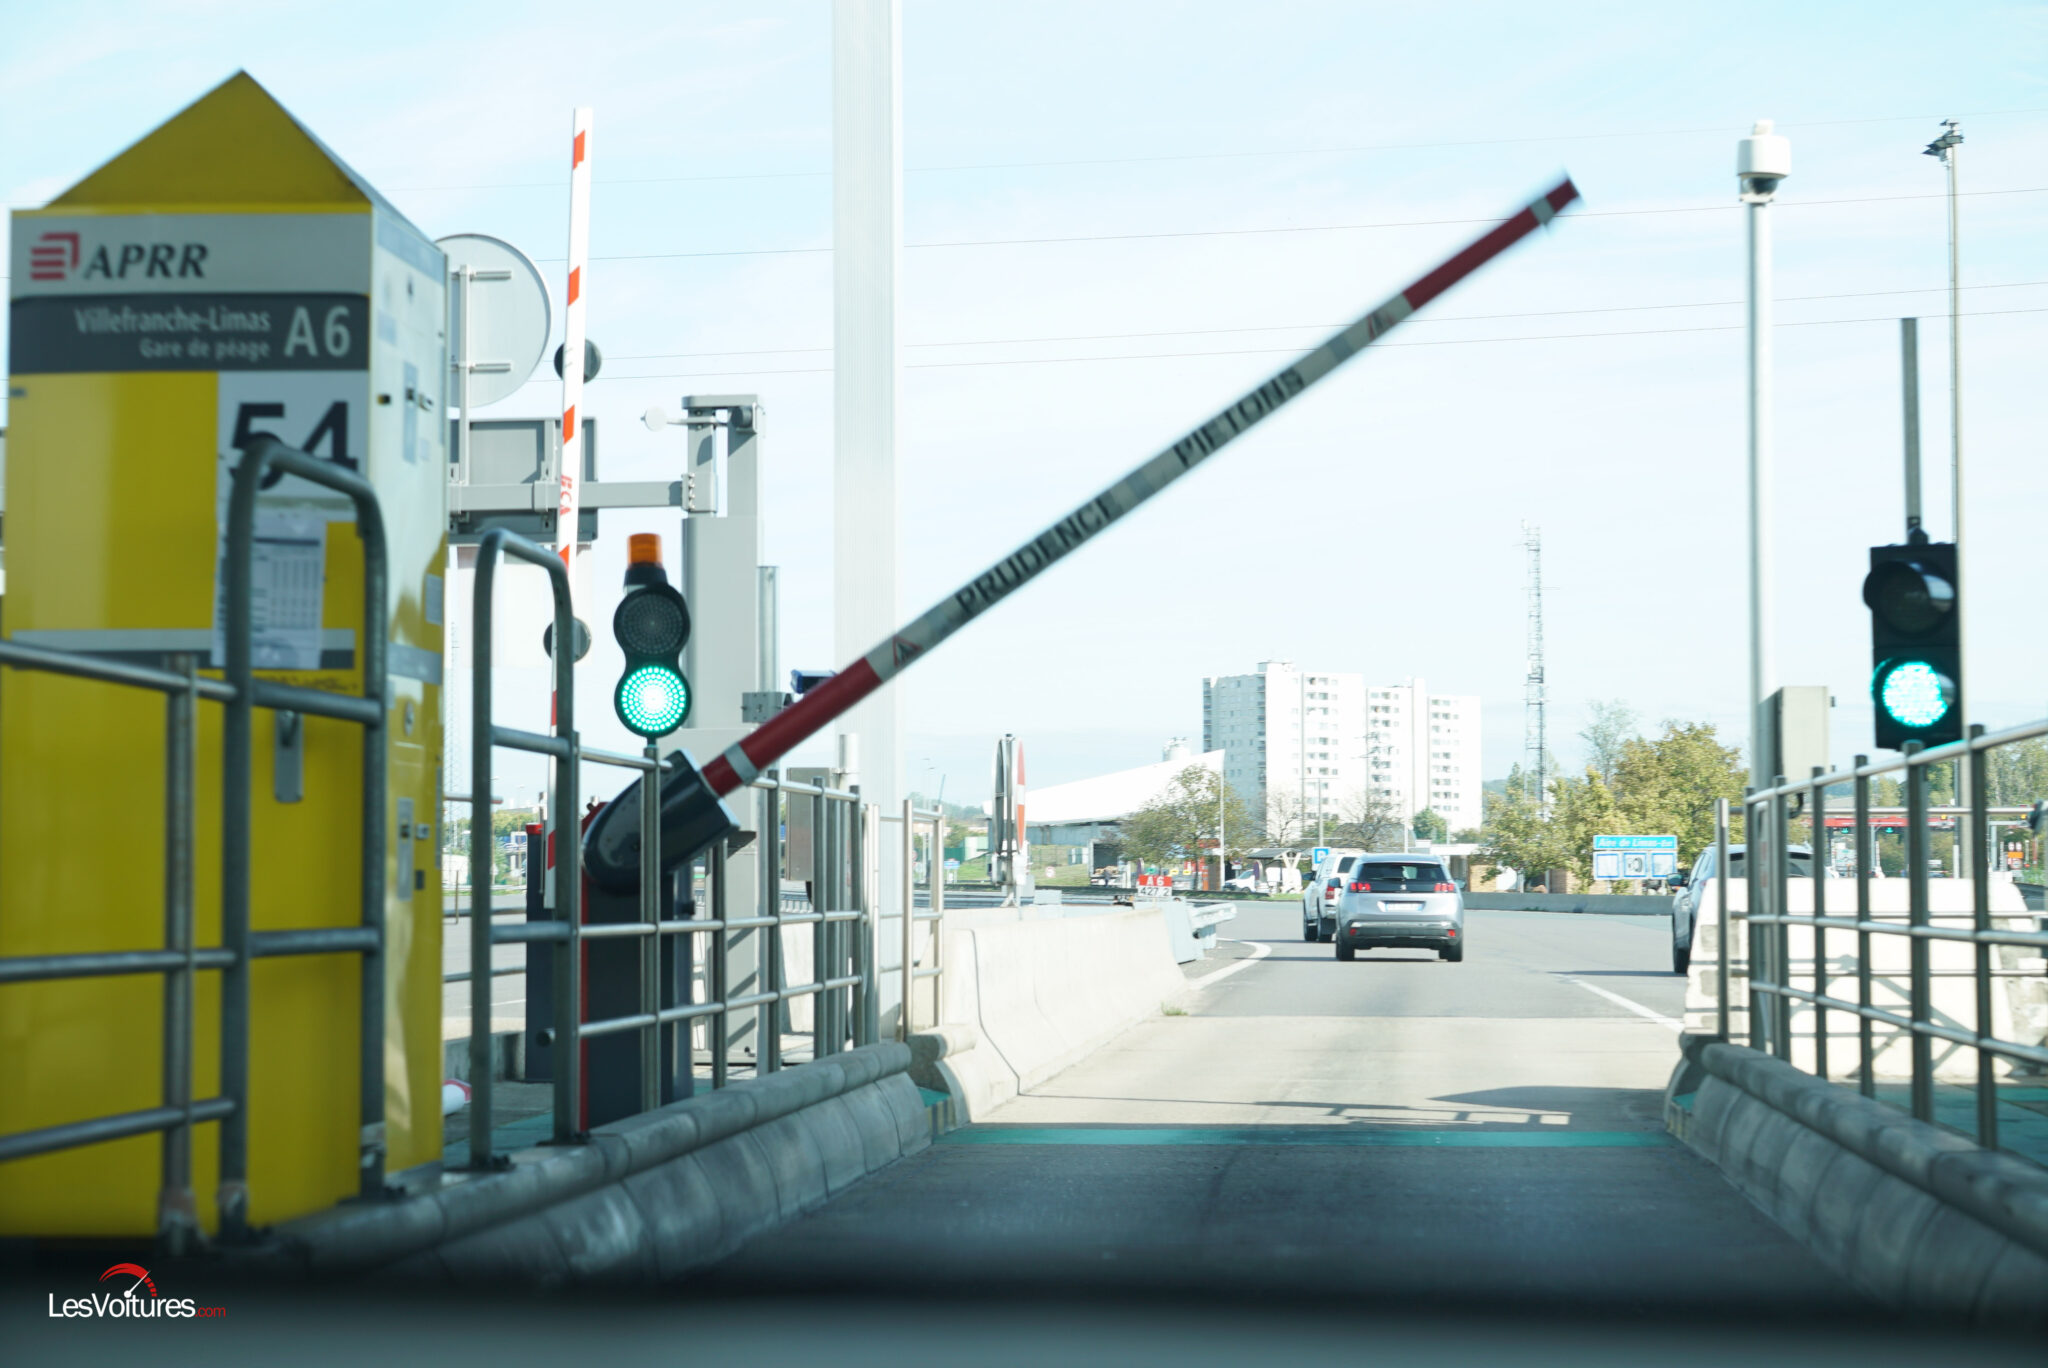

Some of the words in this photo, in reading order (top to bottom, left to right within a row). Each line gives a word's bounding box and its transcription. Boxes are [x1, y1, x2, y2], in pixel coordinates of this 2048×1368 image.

[83, 244, 208, 280] APRR
[73, 305, 271, 334] Villefranche-Limas
[284, 305, 351, 357] A6
[139, 338, 181, 358] Gare
[186, 338, 210, 358] de
[228, 400, 359, 491] 54
[953, 490, 1121, 617] PRUDENCE
[1172, 366, 1305, 469] PIETONS
[1146, 876, 1165, 886] A6
